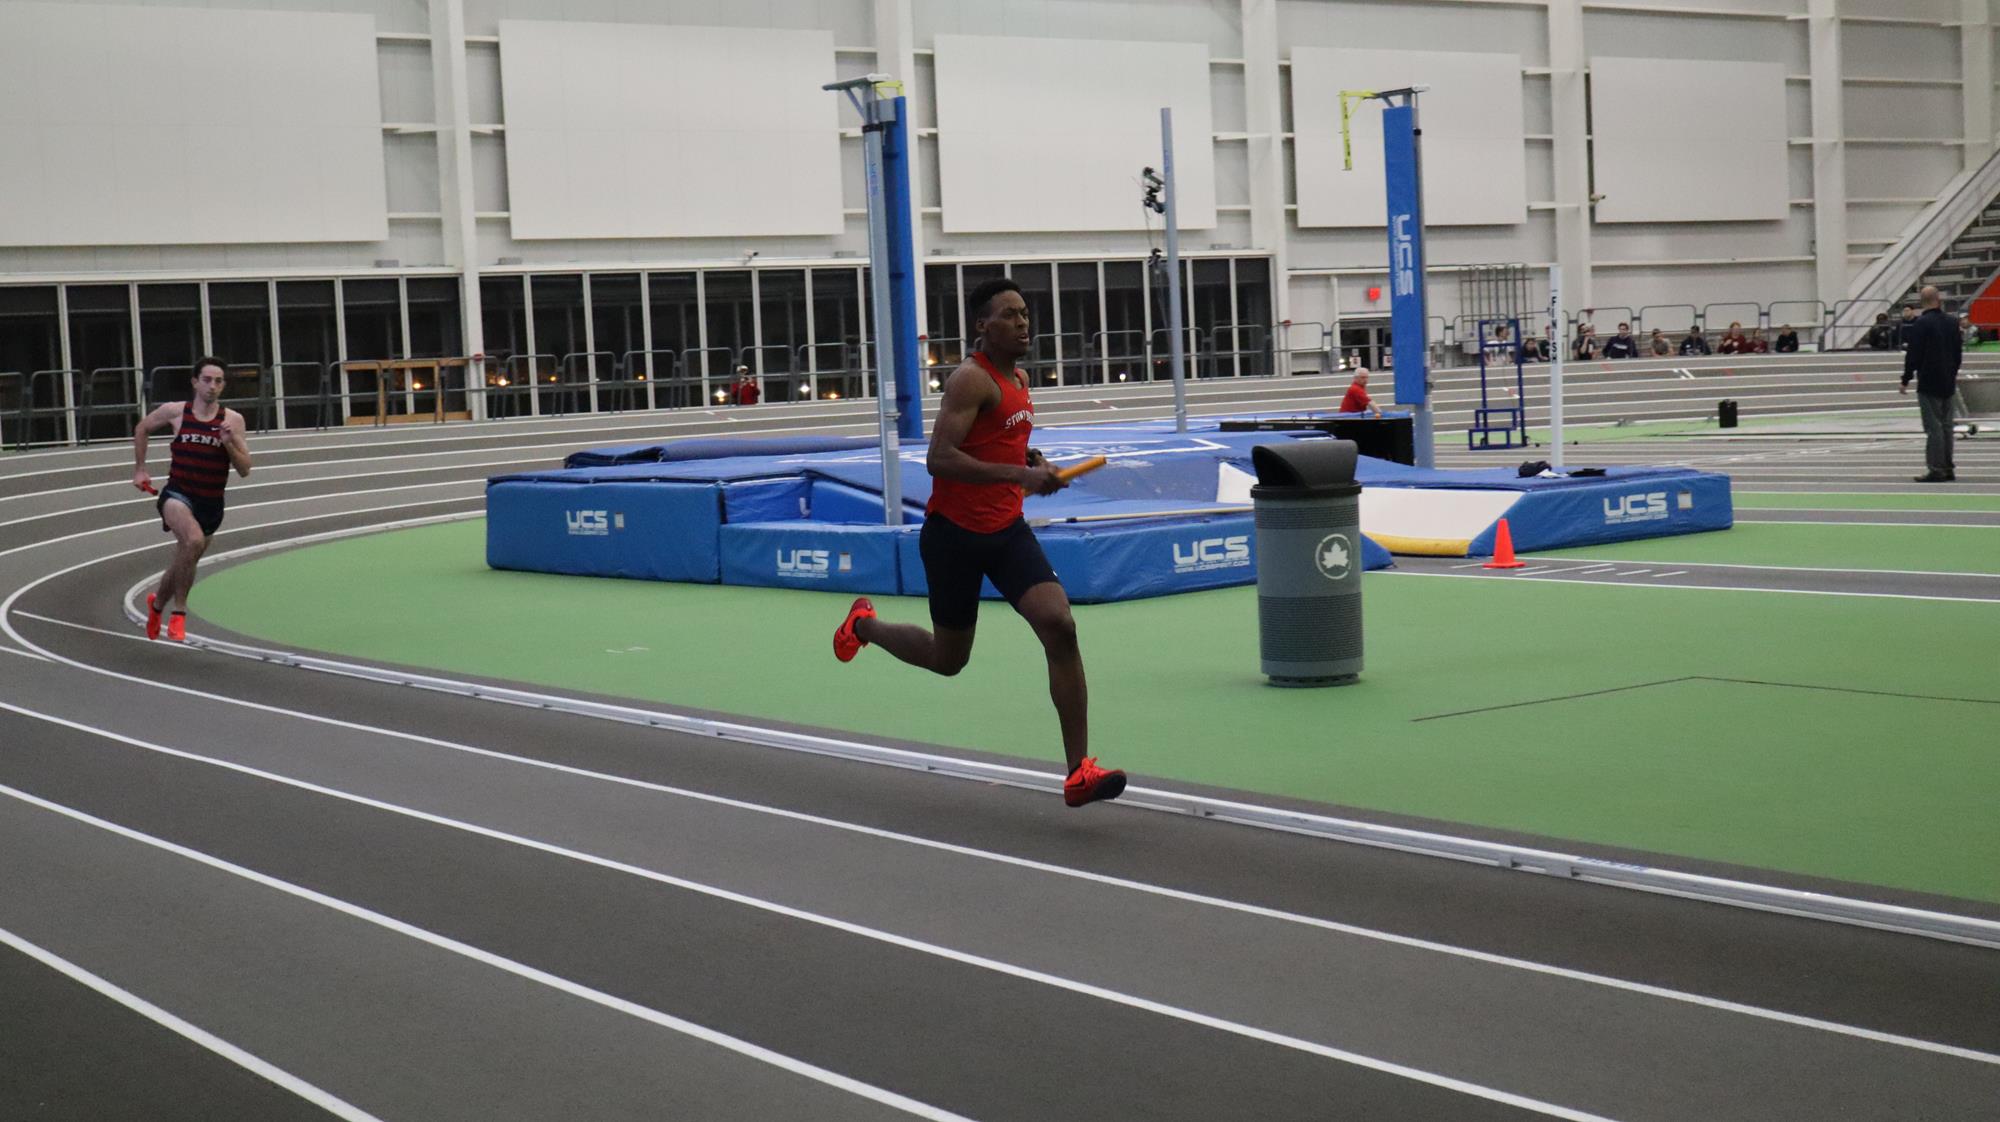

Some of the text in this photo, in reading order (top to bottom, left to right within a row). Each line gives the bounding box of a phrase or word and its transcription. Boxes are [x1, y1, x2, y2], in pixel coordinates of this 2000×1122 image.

[1397, 214, 1413, 295] UCS
[181, 434, 221, 447] PENN
[1603, 492, 1667, 516] UCS
[566, 510, 608, 529] UCS
[776, 549, 829, 569] UCS
[1173, 535, 1249, 564] UCS
